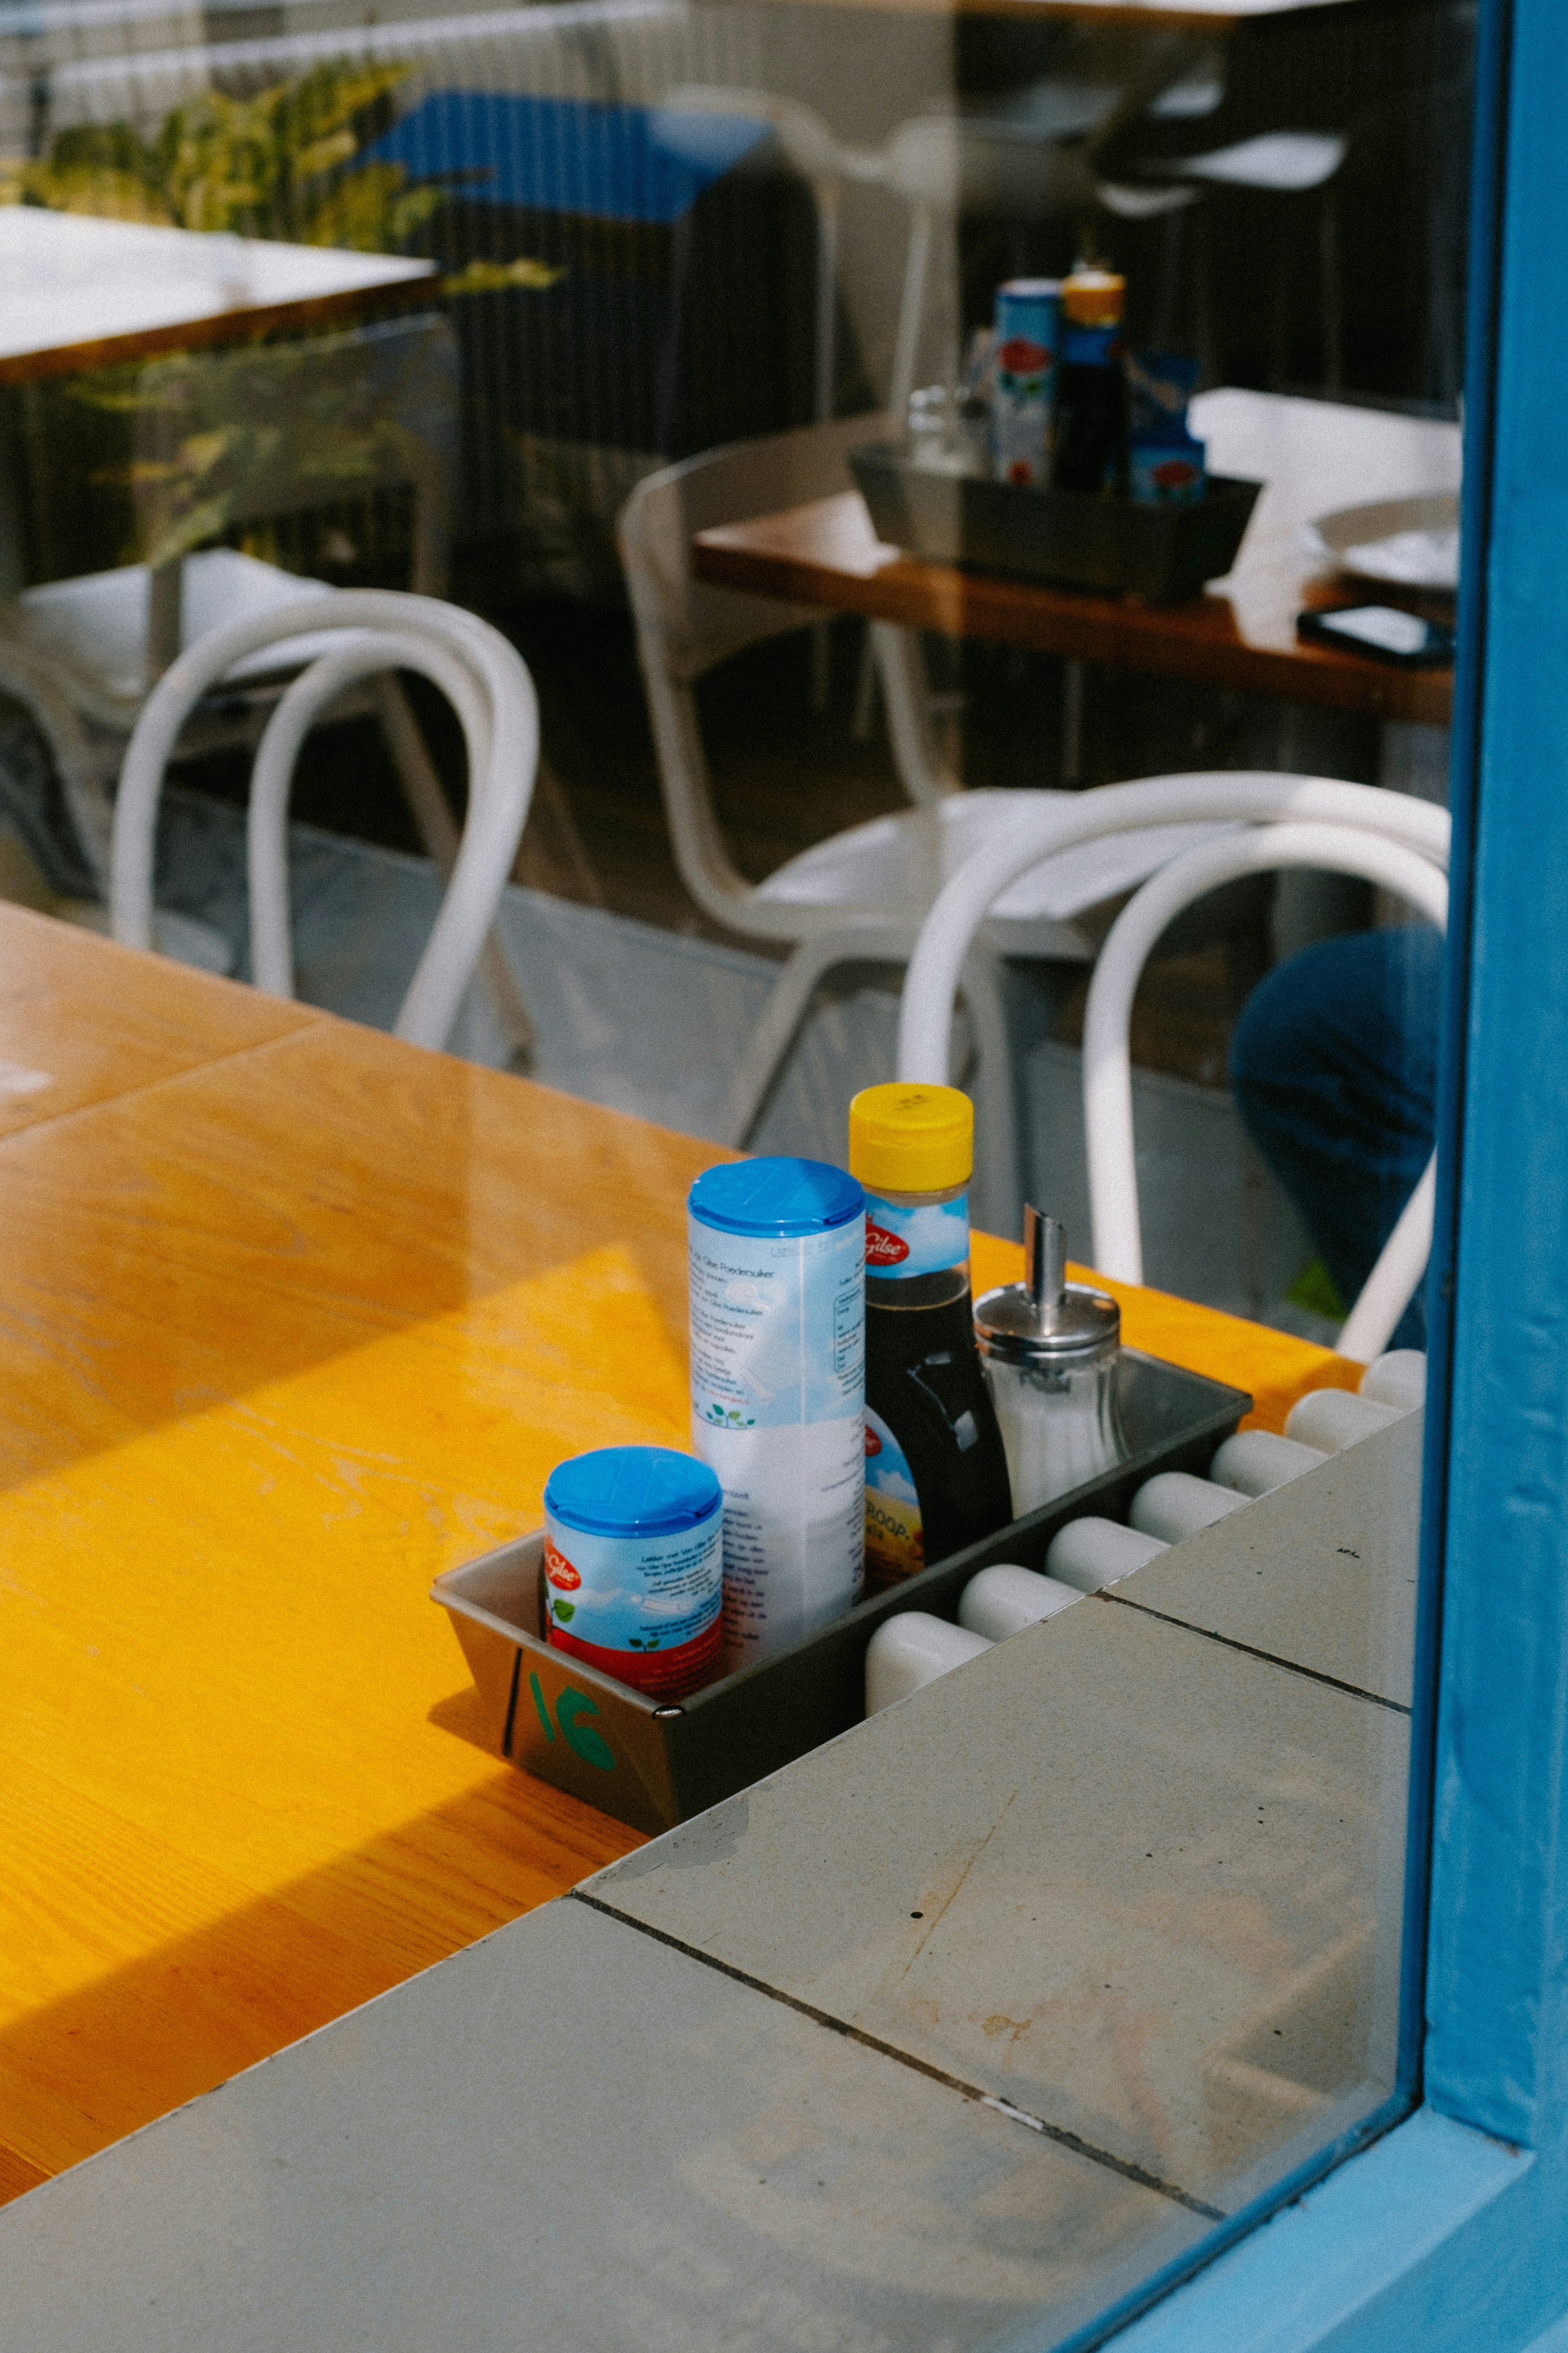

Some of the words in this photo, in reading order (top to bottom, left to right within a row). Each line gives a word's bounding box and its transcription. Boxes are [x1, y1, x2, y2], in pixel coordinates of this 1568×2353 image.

[866, 1232, 901, 1258] Gilse
[866, 1500, 910, 1541] ROOP.
[548, 1554, 575, 1582] Gilse
[529, 1670, 616, 1771] 16
